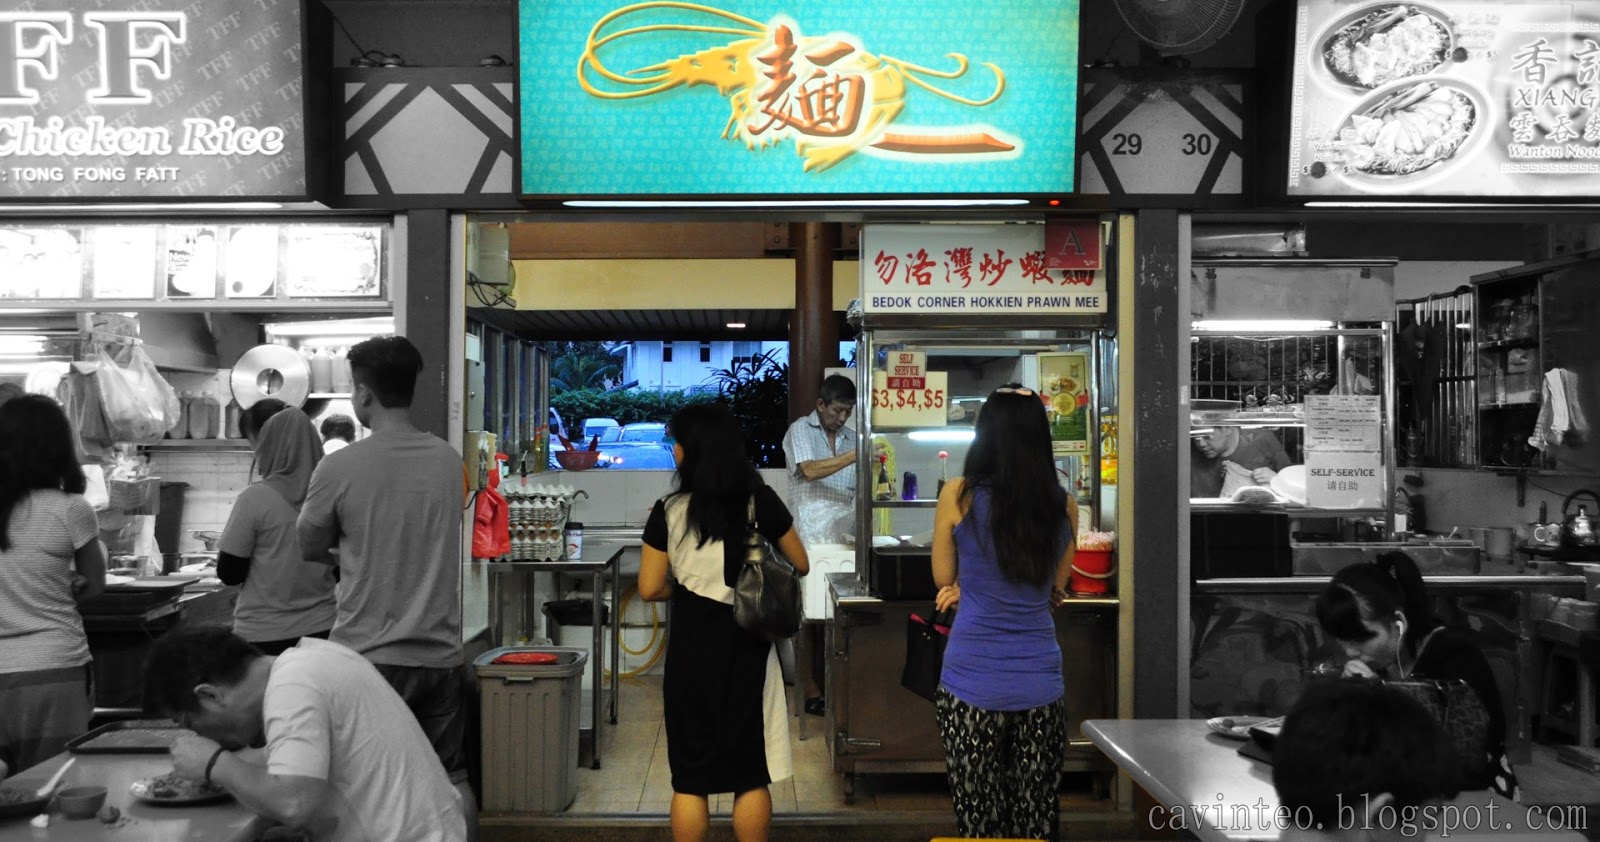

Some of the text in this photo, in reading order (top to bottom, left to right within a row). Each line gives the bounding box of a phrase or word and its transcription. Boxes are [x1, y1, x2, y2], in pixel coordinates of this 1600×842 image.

[207, 11, 241, 40] TFF
[245, 22, 281, 50] TFF
[0, 12, 187, 104] FF
[198, 51, 233, 80] TFF
[236, 62, 272, 91] TFF
[1515, 88, 1598, 108] XIANG
[0, 115, 284, 156] Chicken Rice
[1112, 133, 1142, 155] 29
[1182, 133, 1211, 155] 30
[1509, 144, 1561, 158] Wanton
[12, 167, 64, 181] TONG
[74, 167, 126, 181] FONG
[136, 167, 180, 181] FATT
[260, 152, 293, 180] TFF
[1059, 228, 1086, 255] A
[872, 296, 1099, 308] BEDOK CORNER HOKKIEN PRAWN MEE
[899, 353, 914, 364] SELF
[894, 365, 919, 376] SERVICE
[872, 388, 944, 411] $3,$4,$5
[1311, 468, 1375, 477] SELF-SERVICE
